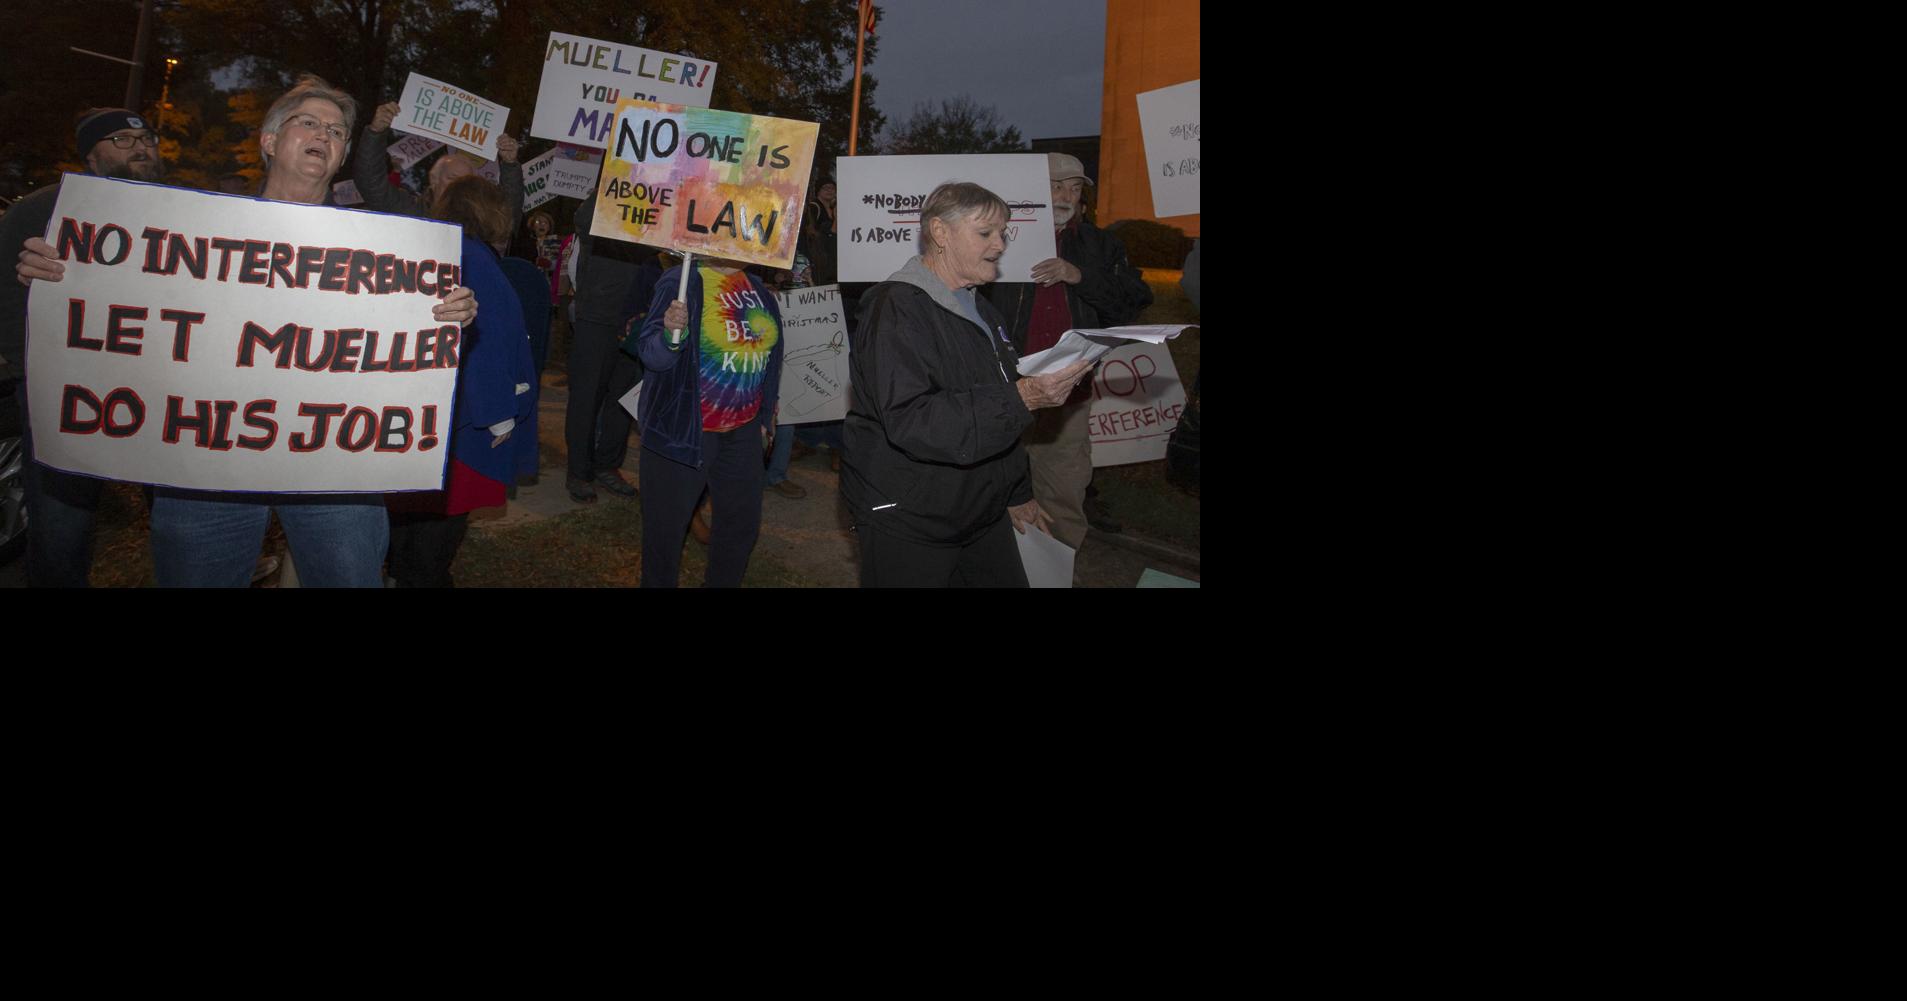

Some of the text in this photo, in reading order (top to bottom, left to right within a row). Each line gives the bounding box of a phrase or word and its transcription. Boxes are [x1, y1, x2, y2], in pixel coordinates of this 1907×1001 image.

[546, 39, 710, 88] MUELLER!
[415, 87, 494, 128] IS ABOVE
[441, 85, 480, 105] NO ONE
[582, 83, 620, 104] YOU
[412, 105, 488, 146] THE LAW
[568, 107, 615, 142] MA
[615, 117, 791, 169] NO ONE IS
[528, 156, 554, 176] STAN
[605, 177, 778, 246] ABOVE LAW
[616, 203, 660, 225] THE
[57, 217, 132, 266] NO
[851, 227, 911, 243] IS ABOVE
[720, 290, 765, 309] JUST
[799, 289, 841, 305] WANT
[67, 298, 460, 373] LET MUELLER
[59, 384, 439, 453] DO HIS JOB!
